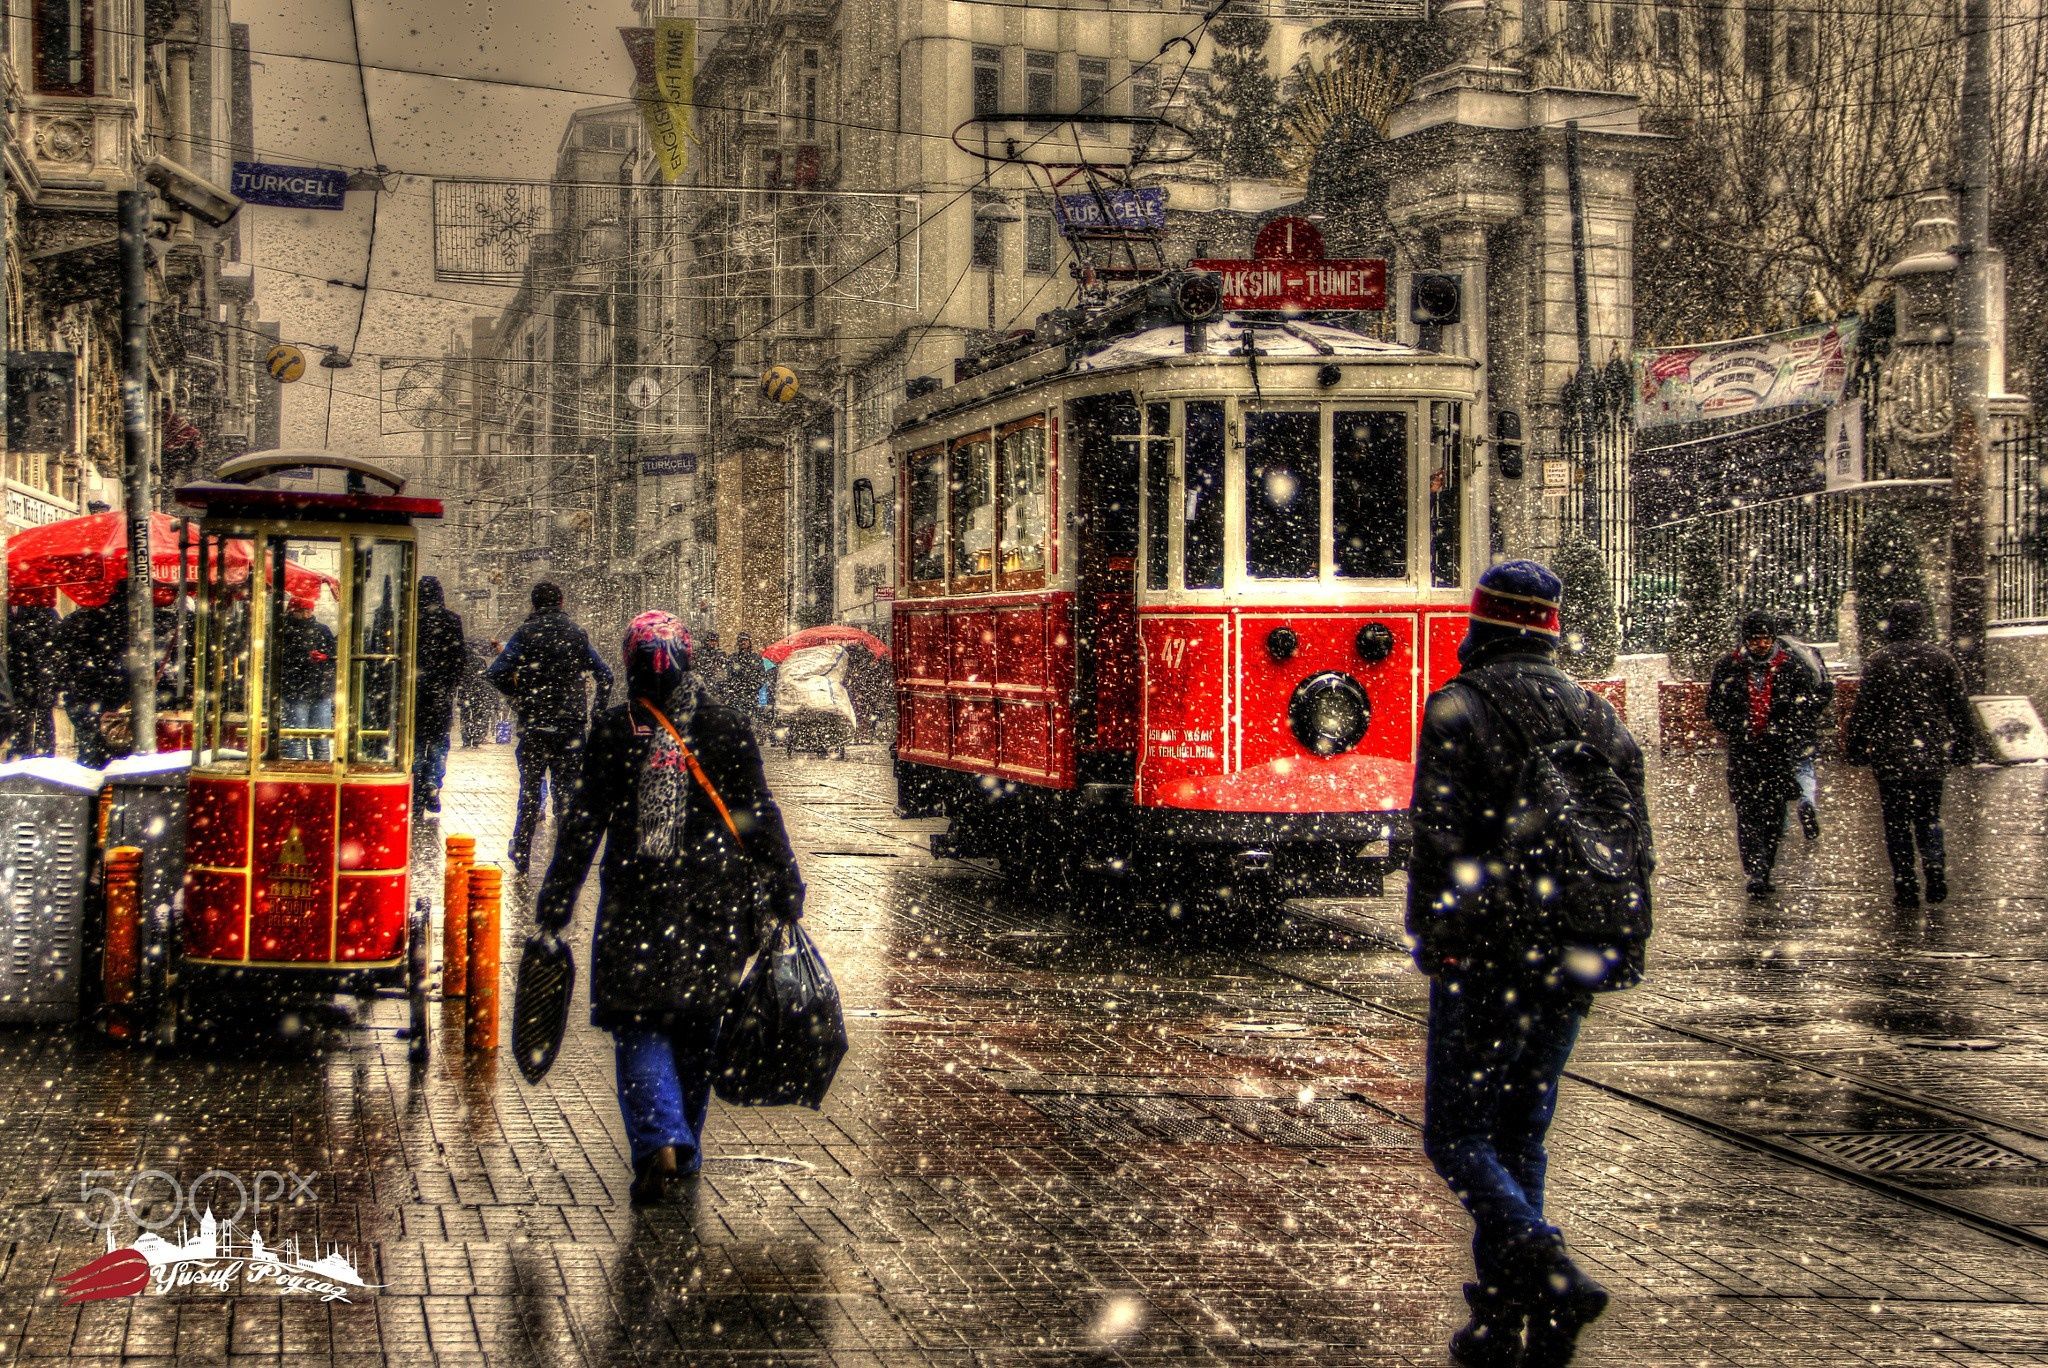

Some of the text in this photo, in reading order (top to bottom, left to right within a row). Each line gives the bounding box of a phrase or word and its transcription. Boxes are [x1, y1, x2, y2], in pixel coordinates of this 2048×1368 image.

[667, 29, 684, 70] TIME
[652, 102, 682, 170] ENGLISH
[236, 173, 339, 197] TURKCELL
[1286, 222, 1293, 253] 1
[1222, 267, 1282, 297] AKSİM
[1305, 266, 1371, 296] TÜNEL
[646, 459, 694, 470] TURKCELL
[1161, 638, 1186, 669] 47
